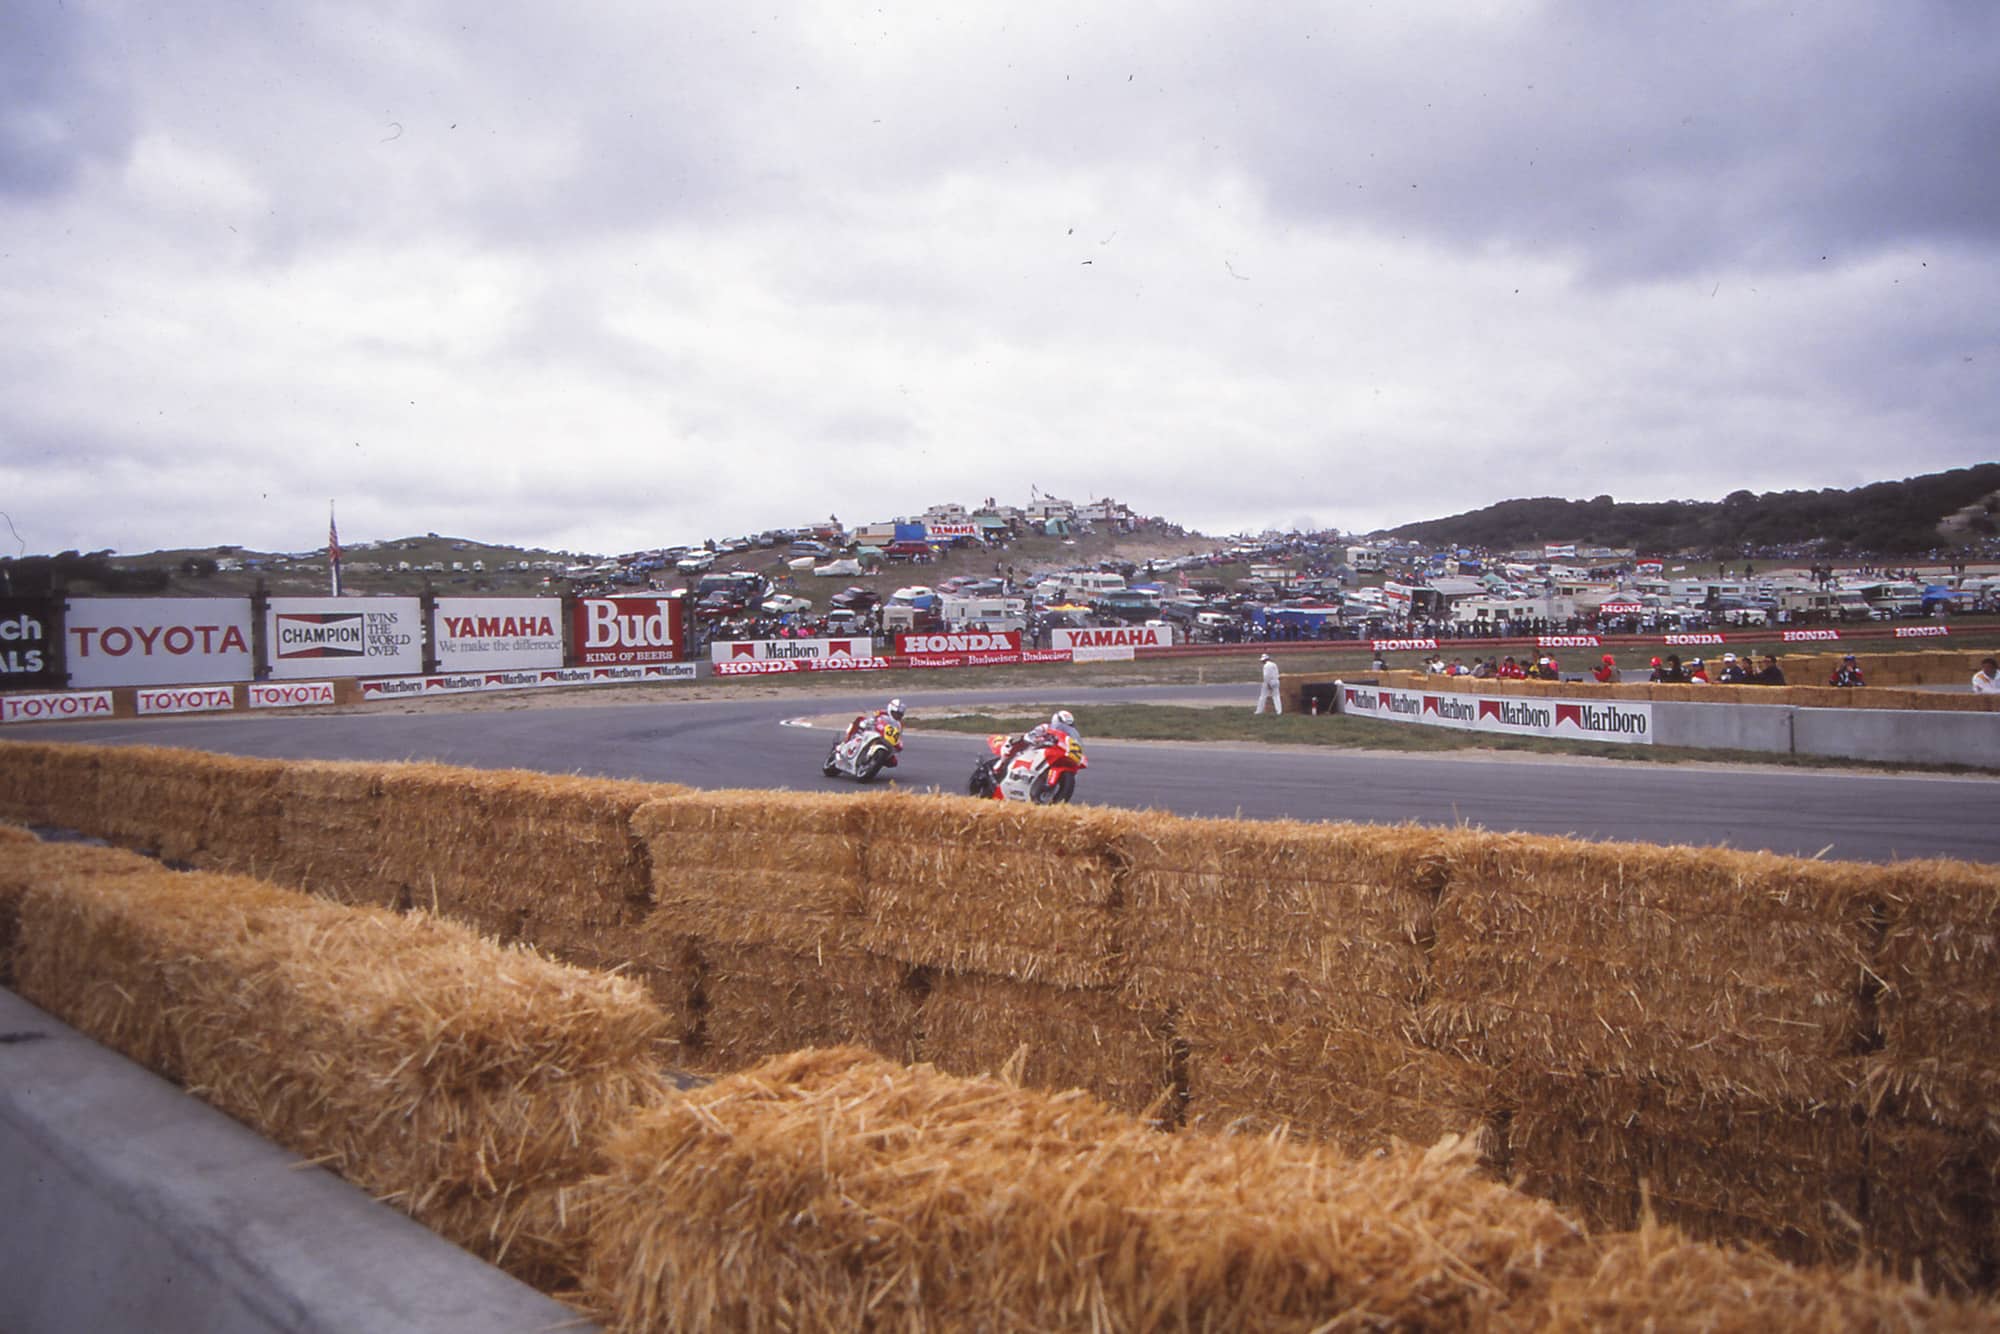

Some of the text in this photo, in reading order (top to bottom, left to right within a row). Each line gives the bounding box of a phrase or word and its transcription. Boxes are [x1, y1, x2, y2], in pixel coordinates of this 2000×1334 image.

[367, 613, 399, 623] WINS
[583, 599, 673, 648] Bud
[368, 624, 392, 635] THE
[443, 616, 554, 638] YAMAHA
[1895, 626, 1949, 637] HONDA
[70, 625, 248, 657] TOYOTA
[282, 627, 360, 643] CHAMPION
[368, 634, 411, 645] WORLD
[1067, 630, 1159, 647] YAMAHA
[1665, 634, 1724, 645] HONDA
[1783, 630, 1840, 642] HONDA
[440, 640, 457, 653] We
[460, 640, 490, 652] make
[493, 639, 510, 651] the
[904, 634, 1012, 653] HONDA
[1373, 640, 1439, 651] HONDA
[1538, 636, 1599, 648] HONDA
[367, 646, 400, 656] OVER
[586, 650, 673, 662] KING OF BEERS
[765, 643, 819, 659] Marlboro
[1022, 651, 1072, 661] Budweiser
[811, 656, 889, 669] HONDA
[910, 656, 960, 666] Budweiser
[968, 654, 1018, 665] Budweiser
[720, 660, 800, 674] HONDA
[502, 671, 537, 684] Marlboro
[558, 669, 591, 681] Marlboro
[382, 680, 422, 693] Marlboro
[444, 677, 482, 689] Marlboro
[140, 691, 232, 710] TOYOTA
[252, 686, 334, 703] TOYOTA
[6, 696, 110, 717] TOYOTA
[1391, 692, 1420, 714] Marlboro
[1439, 697, 1475, 720] Marlboro
[1500, 701, 1550, 728] Marlboro
[1581, 705, 1647, 734] Marlboro
